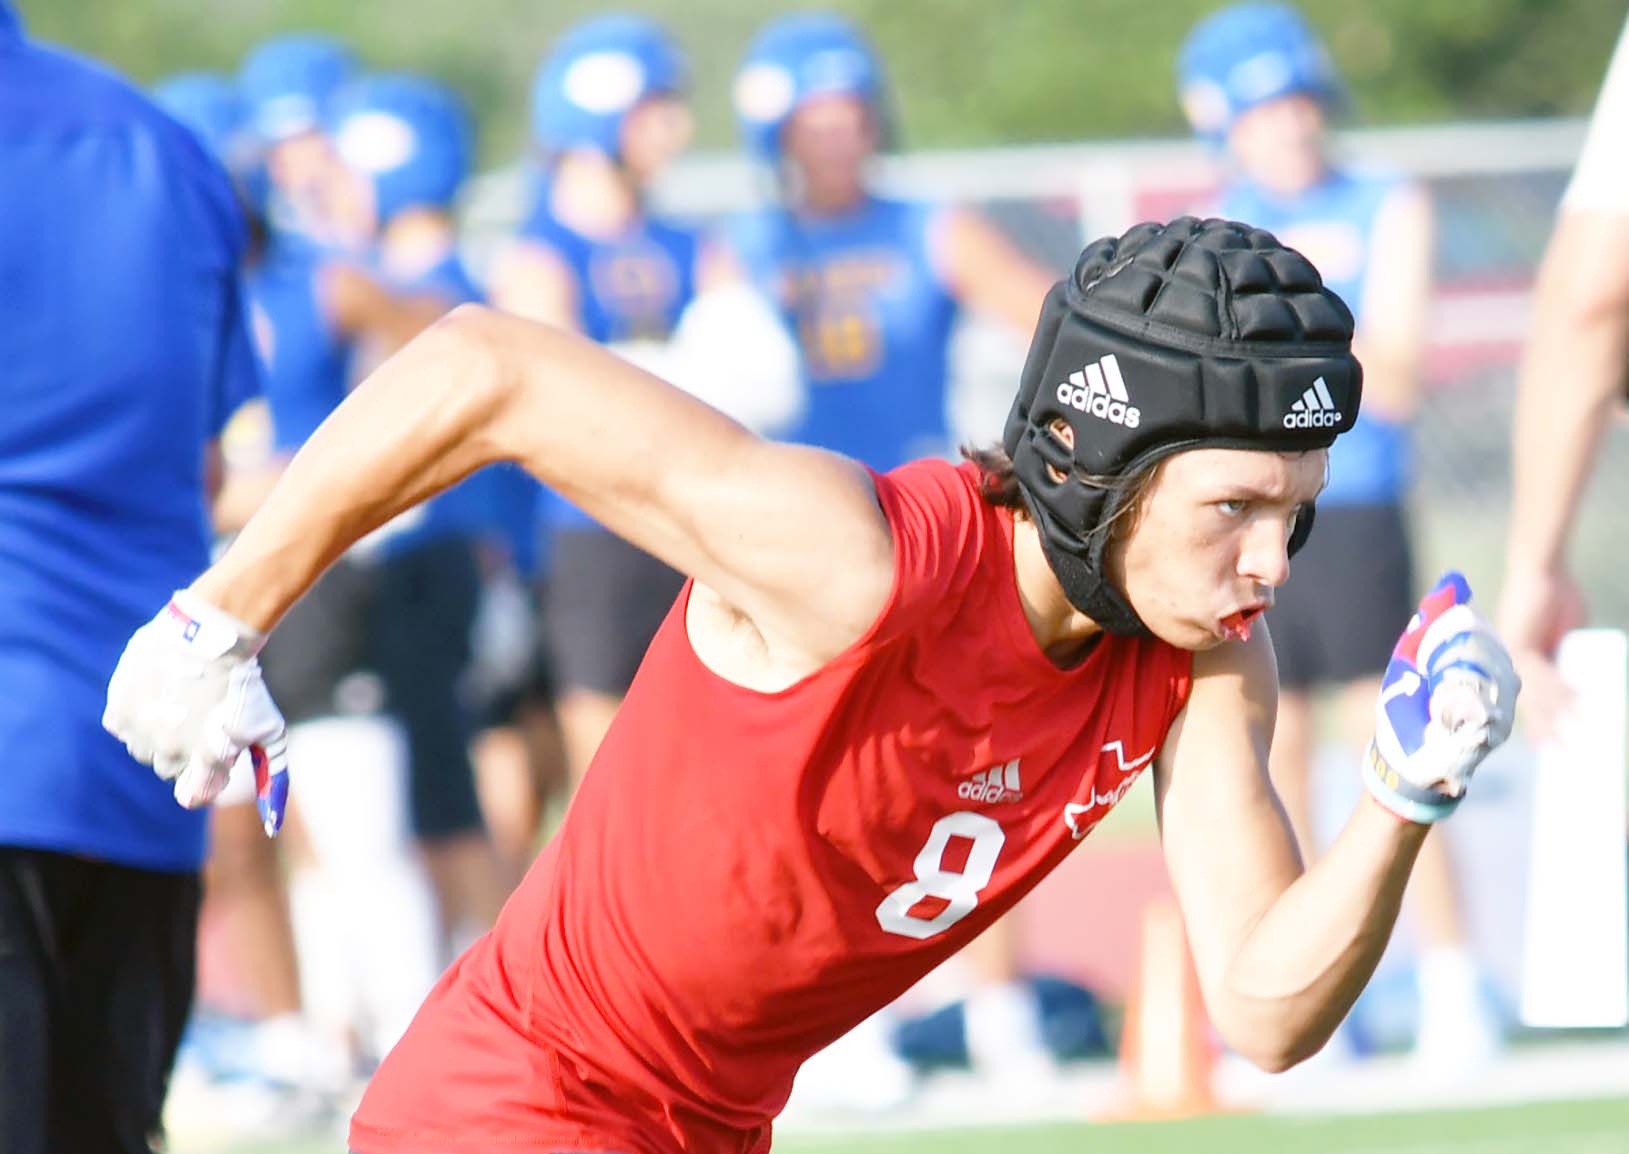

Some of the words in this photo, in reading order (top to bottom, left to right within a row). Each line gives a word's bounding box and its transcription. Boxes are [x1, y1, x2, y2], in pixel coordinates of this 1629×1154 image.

[1056, 382, 1140, 428] adidas
[957, 777, 1023, 804] adid
[875, 811, 1006, 940] 8
